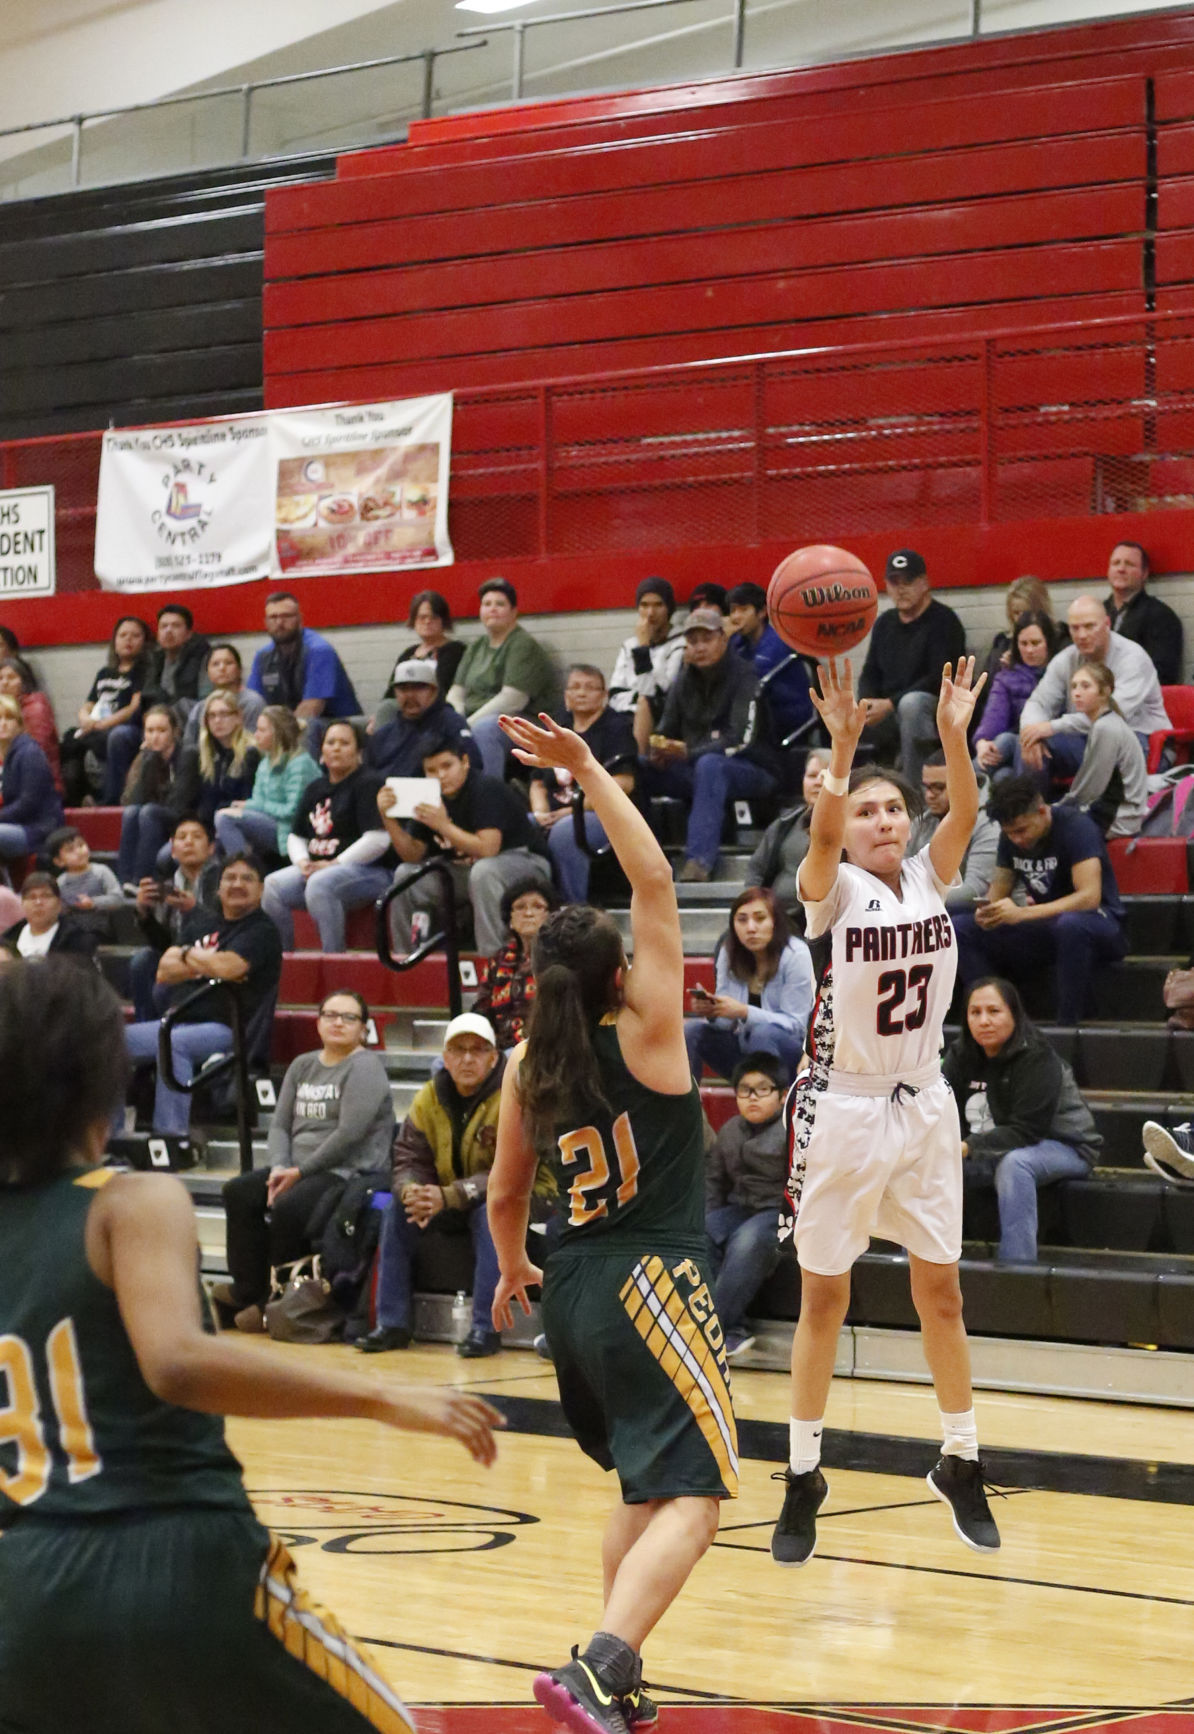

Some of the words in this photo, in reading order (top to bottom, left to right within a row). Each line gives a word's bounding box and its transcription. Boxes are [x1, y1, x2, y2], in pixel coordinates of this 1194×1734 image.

[161, 458, 217, 490] PARTY
[151, 507, 213, 547] CENTRAL
[892, 556, 908, 568] C
[801, 584, 871, 608] Wilson
[845, 914, 952, 963] PANTHERS
[876, 963, 934, 1037] 23
[557, 1110, 641, 1227] 21
